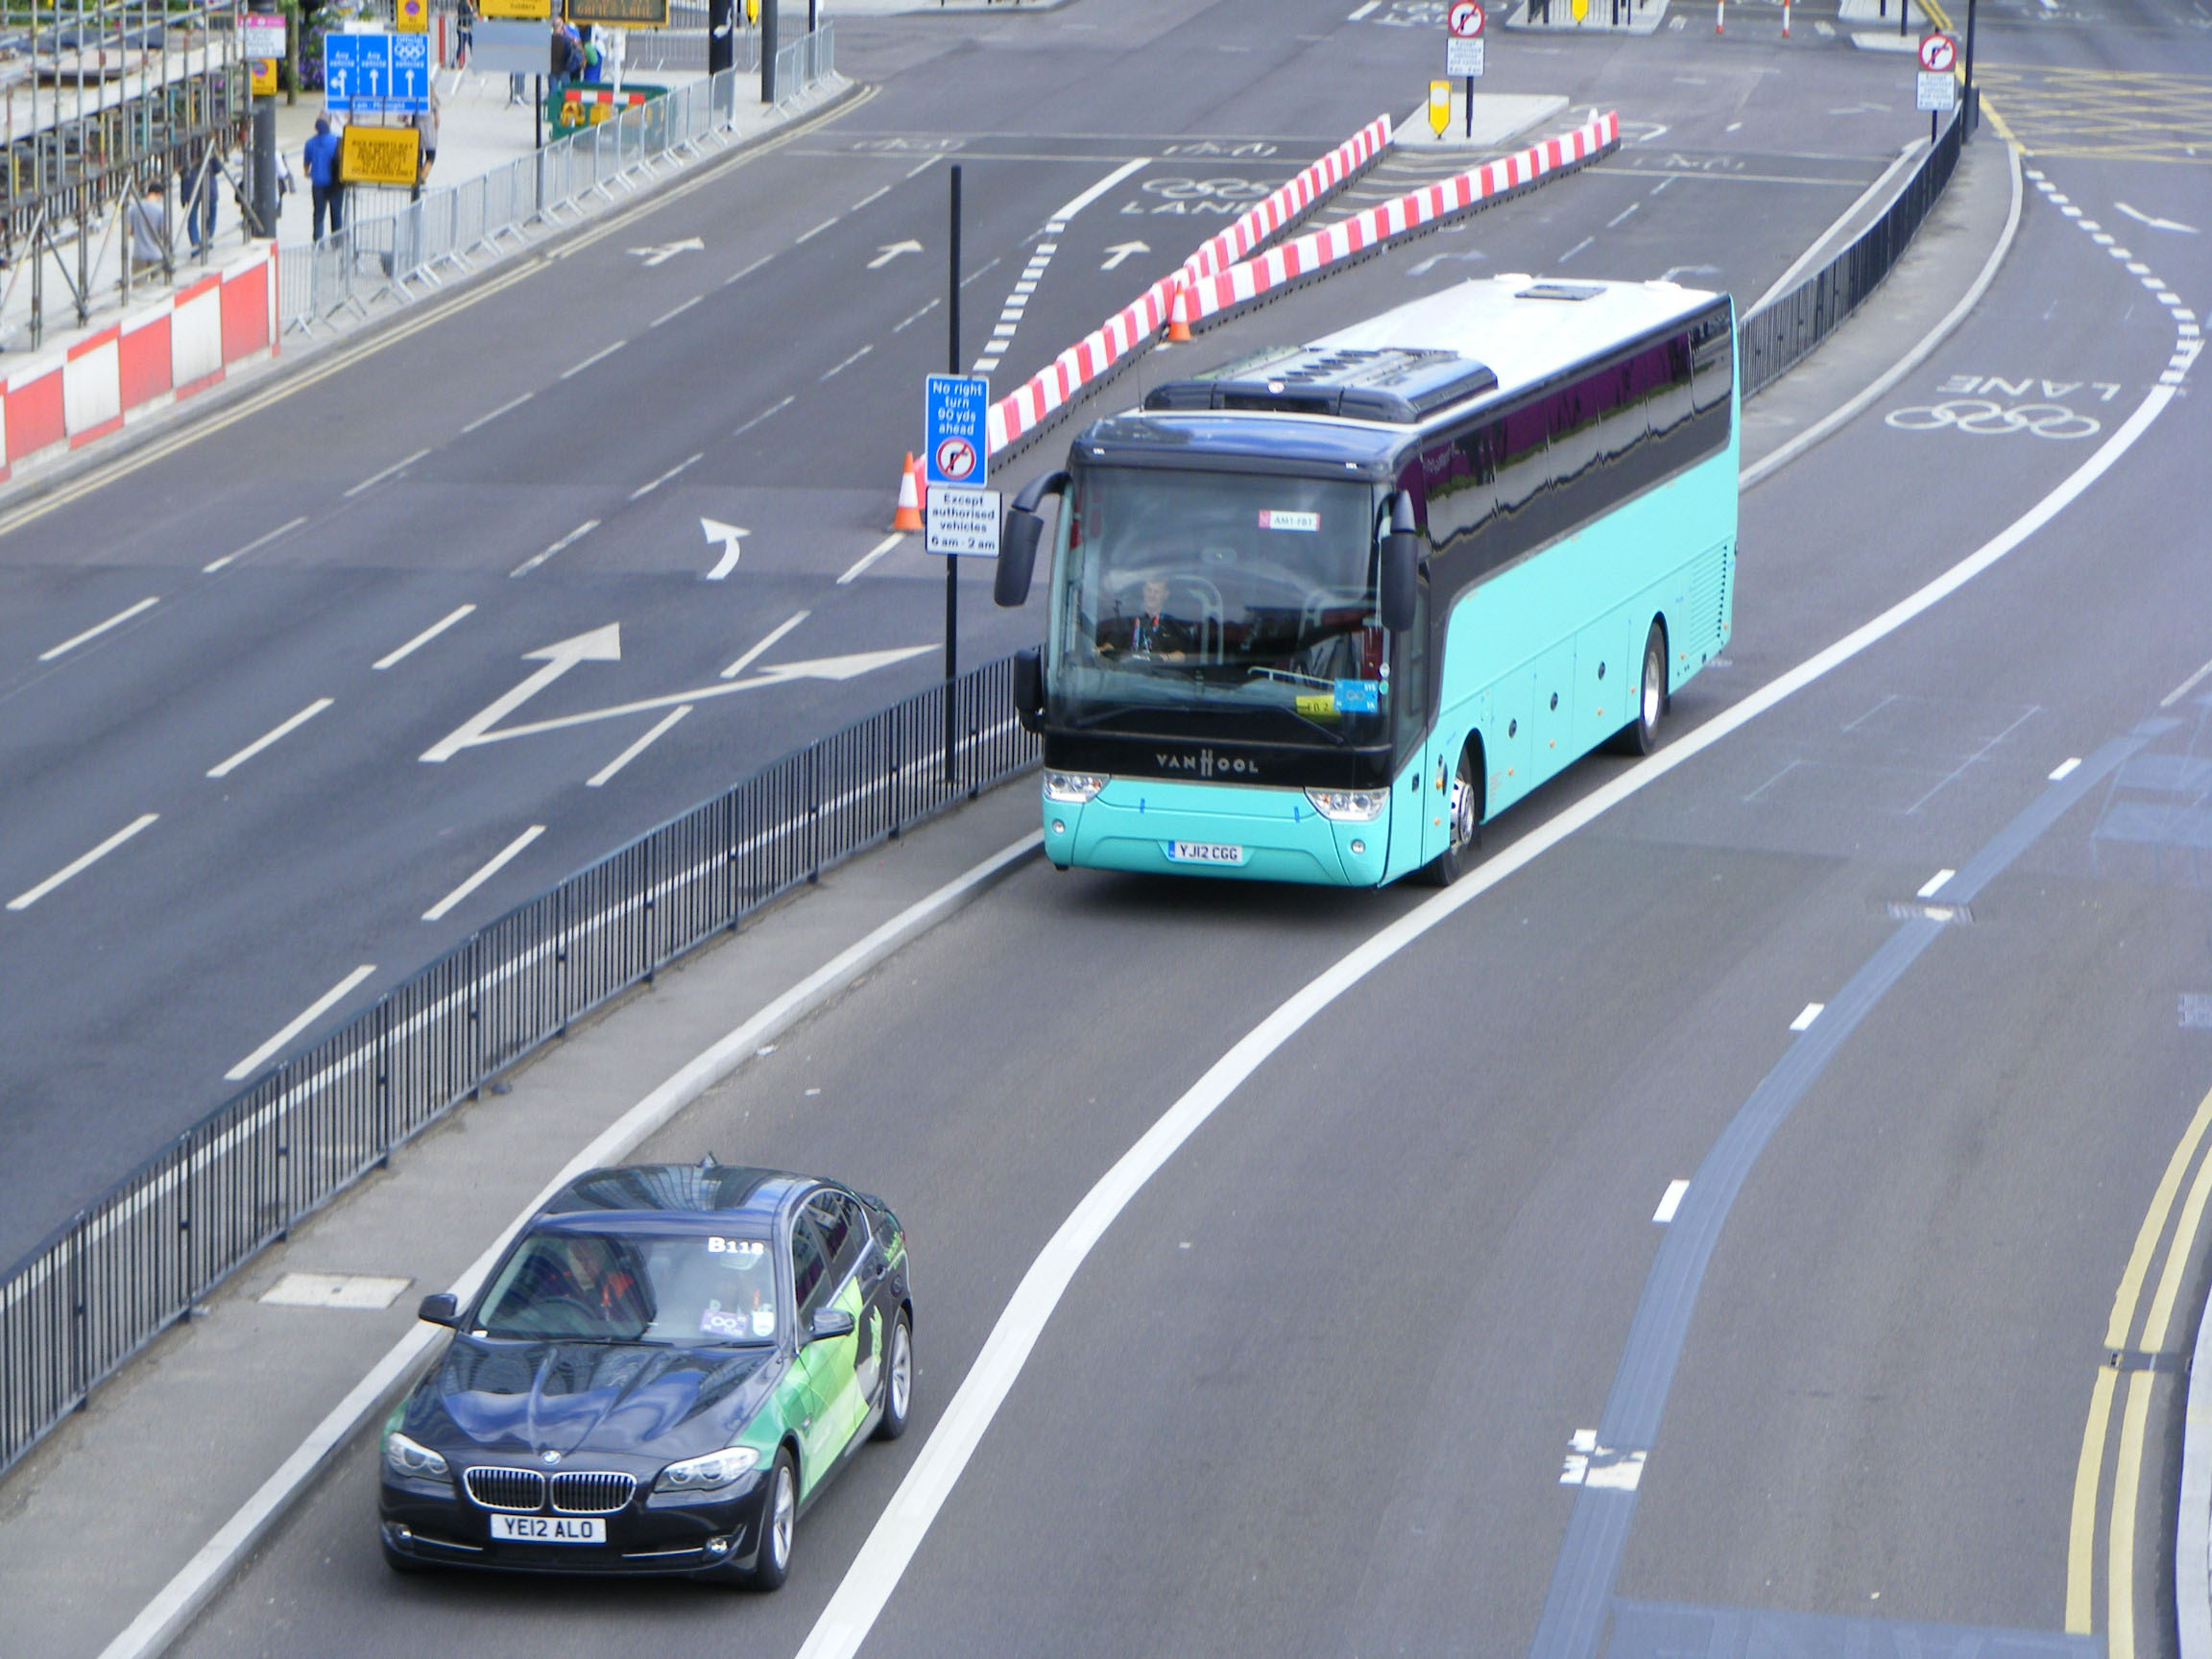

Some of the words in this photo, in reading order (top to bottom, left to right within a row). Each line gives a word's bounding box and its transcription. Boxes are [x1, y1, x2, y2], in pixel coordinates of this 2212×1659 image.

[932, 380, 950, 395] No
[954, 382, 982, 397] right
[1936, 374, 2122, 401] LANE
[945, 396, 970, 408] turn
[956, 409, 976, 422] yds
[938, 421, 974, 435] ahead
[944, 493, 984, 507] Except
[932, 507, 995, 519] authorised
[940, 519, 987, 533] vehicles
[931, 535, 939, 546] 6
[942, 538, 958, 547] am
[968, 537, 975, 548] 2
[978, 540, 996, 550] am
[1179, 844, 1210, 860] YJ12
[1212, 847, 1238, 861] CGG
[505, 1518, 548, 1537] YE12
